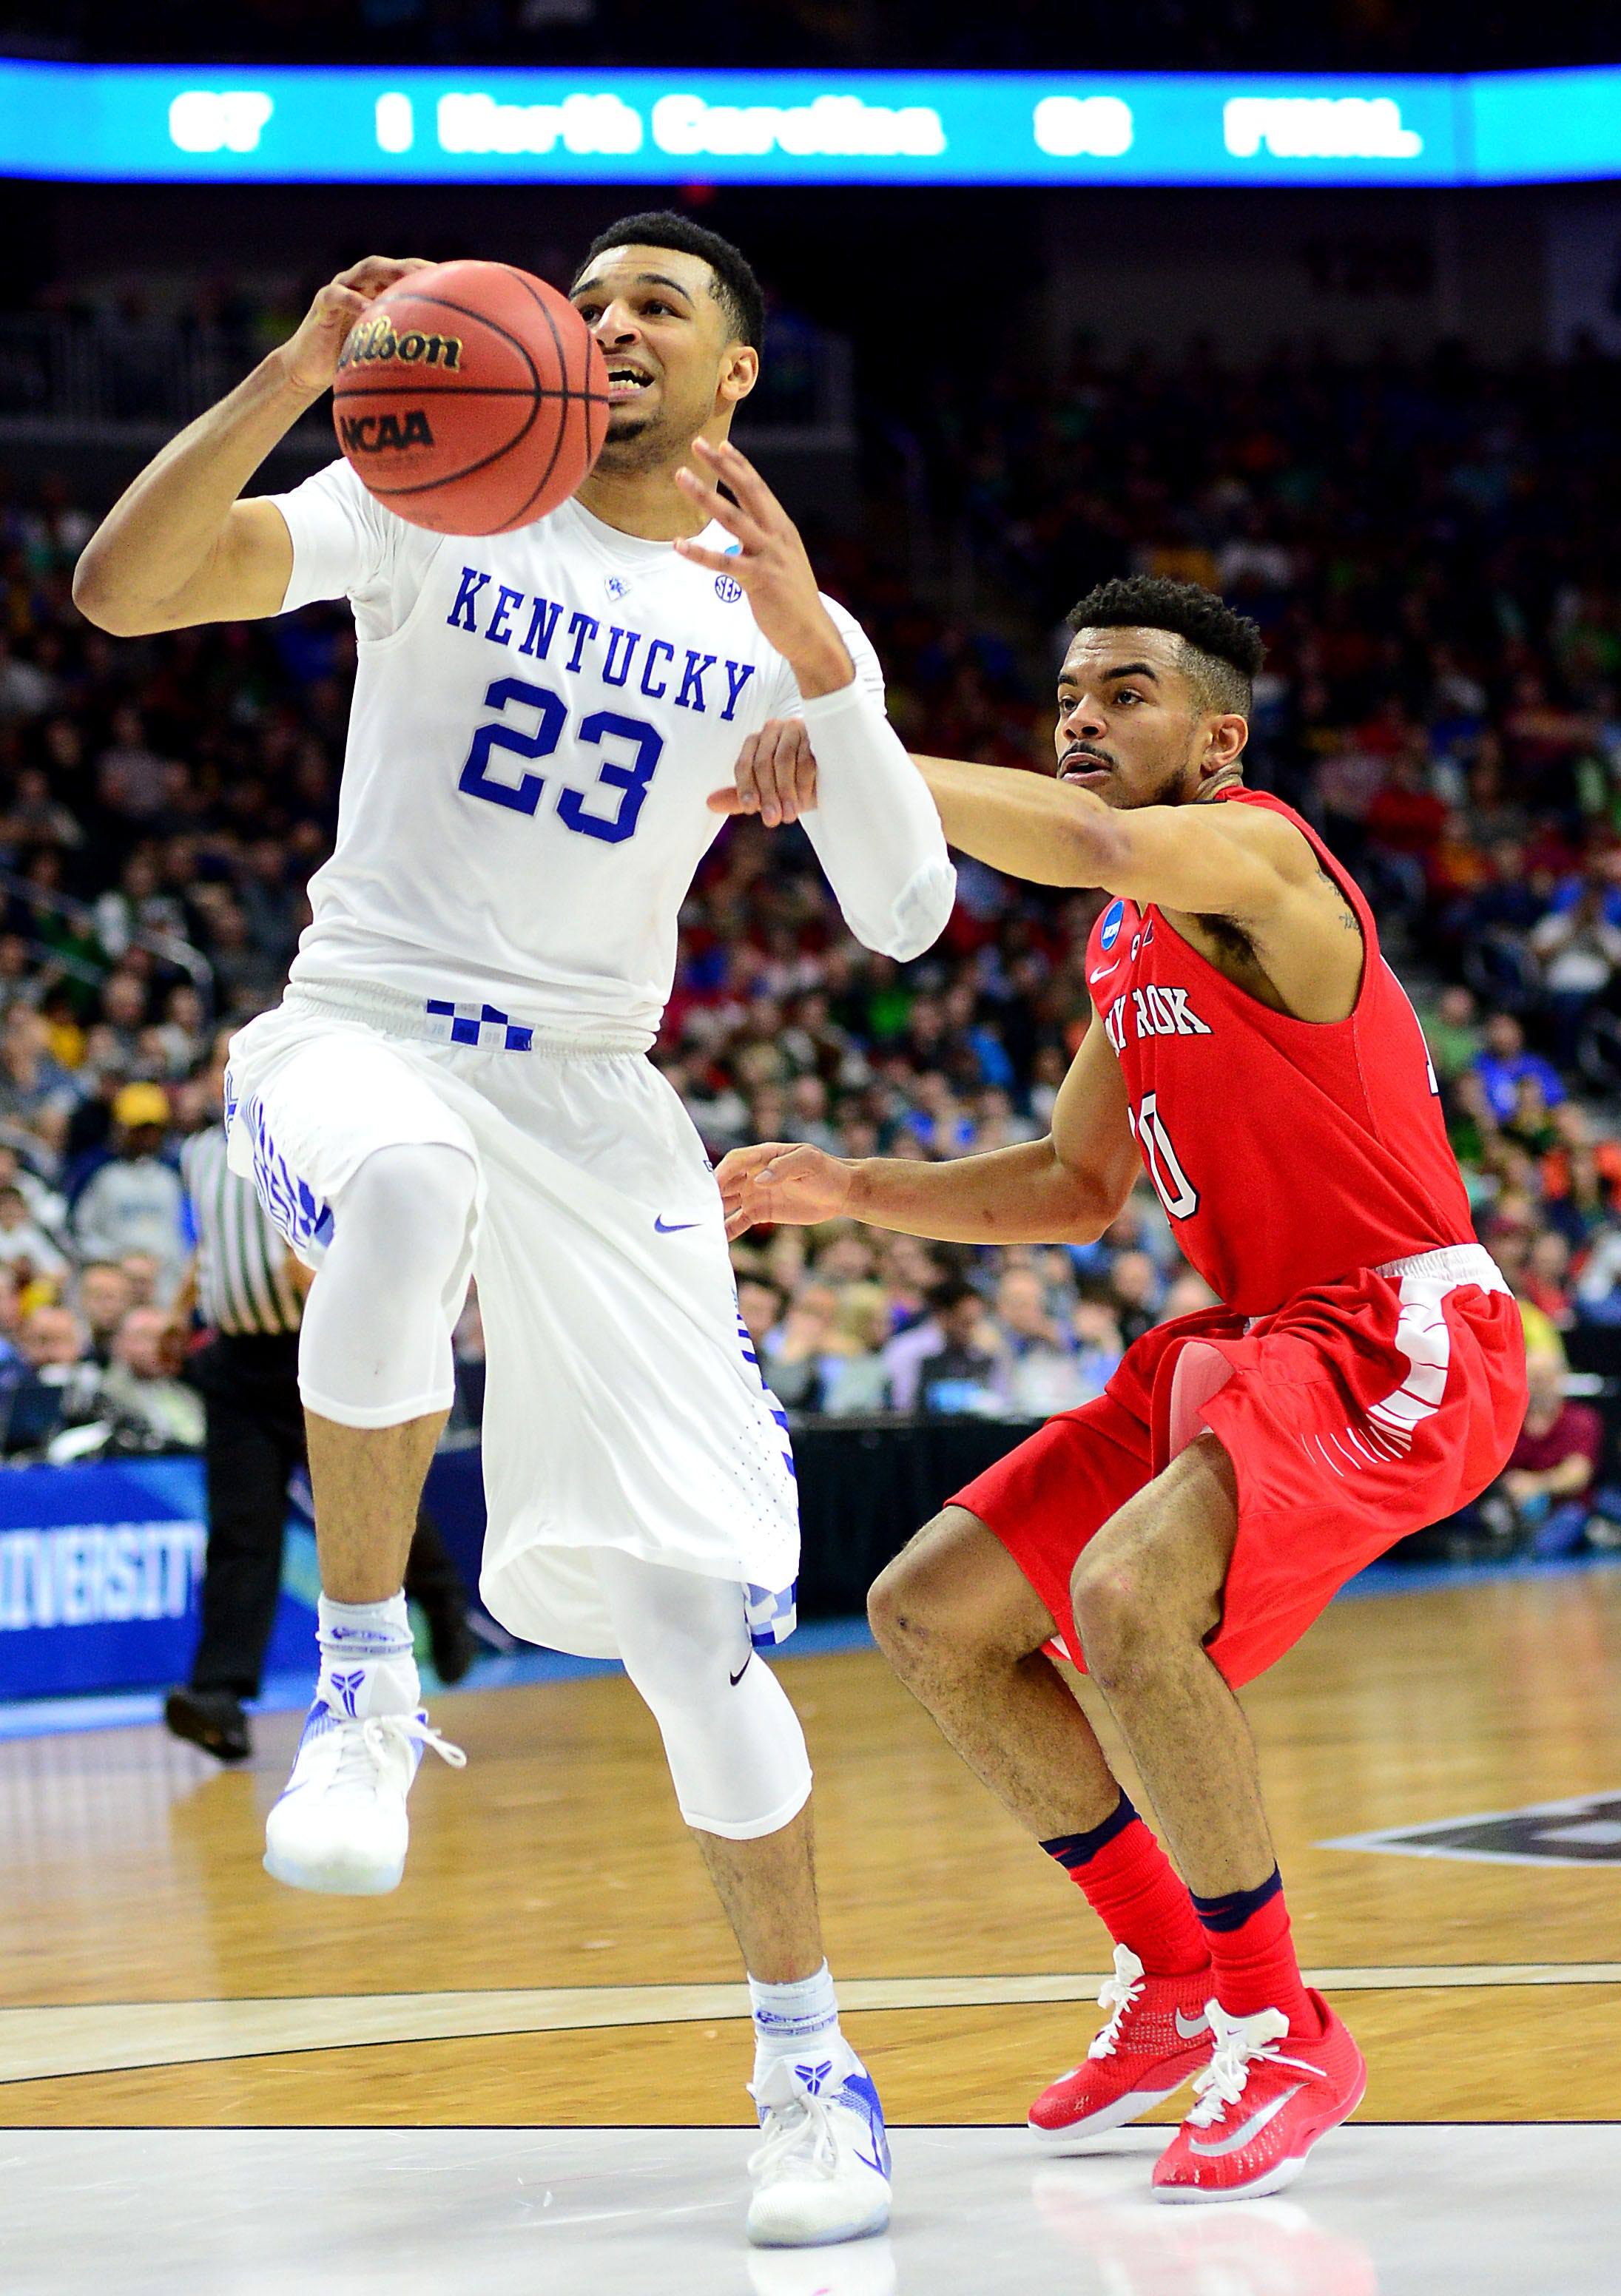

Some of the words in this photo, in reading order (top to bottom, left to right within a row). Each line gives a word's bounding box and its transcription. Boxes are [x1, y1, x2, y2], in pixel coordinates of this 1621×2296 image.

[438, 93, 642, 154] North
[652, 95, 947, 155] Carolina
[340, 411, 434, 453] NCAA
[715, 575, 742, 603] SEC
[447, 567, 755, 721] KENTUCKY
[457, 677, 665, 844] 23
[1128, 1090, 1200, 1228] 0
